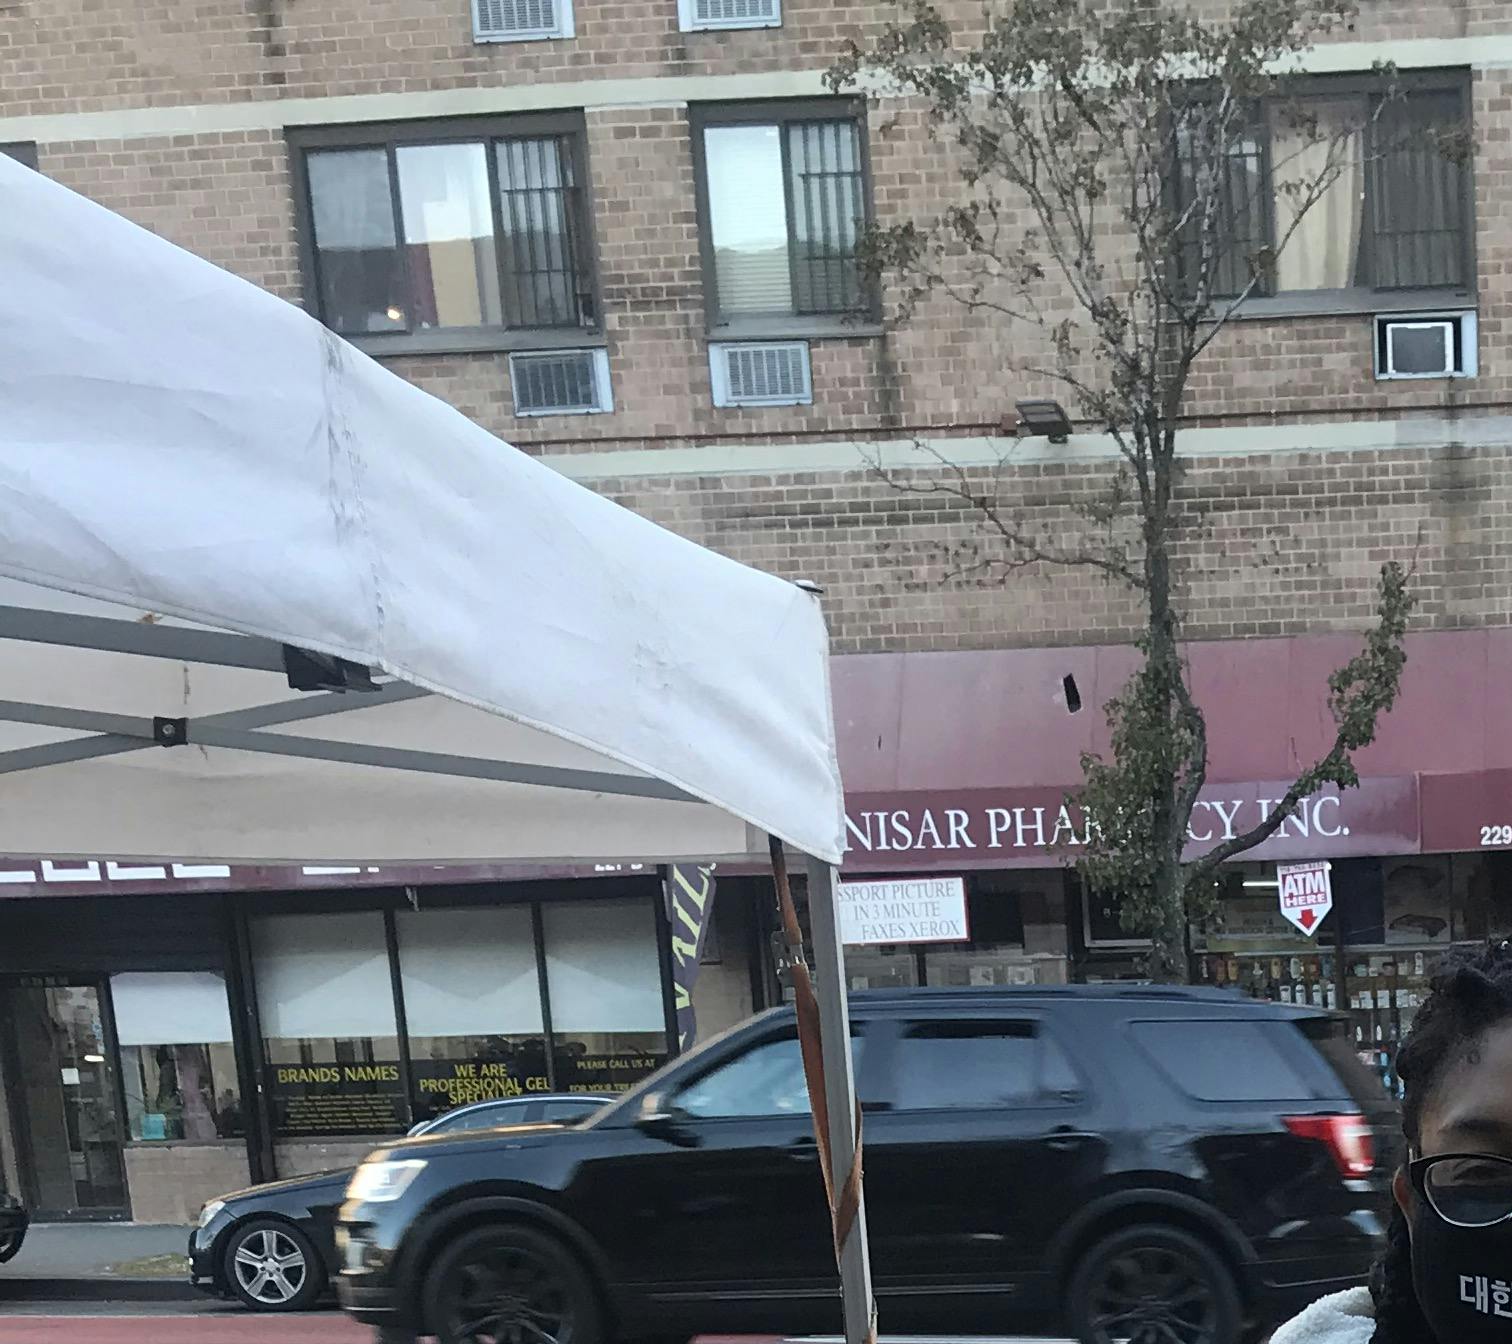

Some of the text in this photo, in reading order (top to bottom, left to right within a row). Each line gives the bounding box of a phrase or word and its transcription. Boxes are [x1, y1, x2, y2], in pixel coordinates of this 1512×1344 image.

[844, 808, 976, 850] NISAR
[985, 799, 1243, 848] PHARCY
[1480, 825, 1512, 845] 229
[892, 882, 954, 900] PICTURE
[1284, 871, 1325, 896] ATM
[1286, 894, 1326, 907] HERE
[855, 902, 940, 920] IN 3 MINUTE
[862, 920, 960, 939] FAXES XEROX
[454, 1063, 507, 1077] WE ARE
[609, 1059, 629, 1068] CALL
[278, 1066, 399, 1083] BRANDS NAMES
[420, 1077, 550, 1092] PROFESSIONAL GEL
